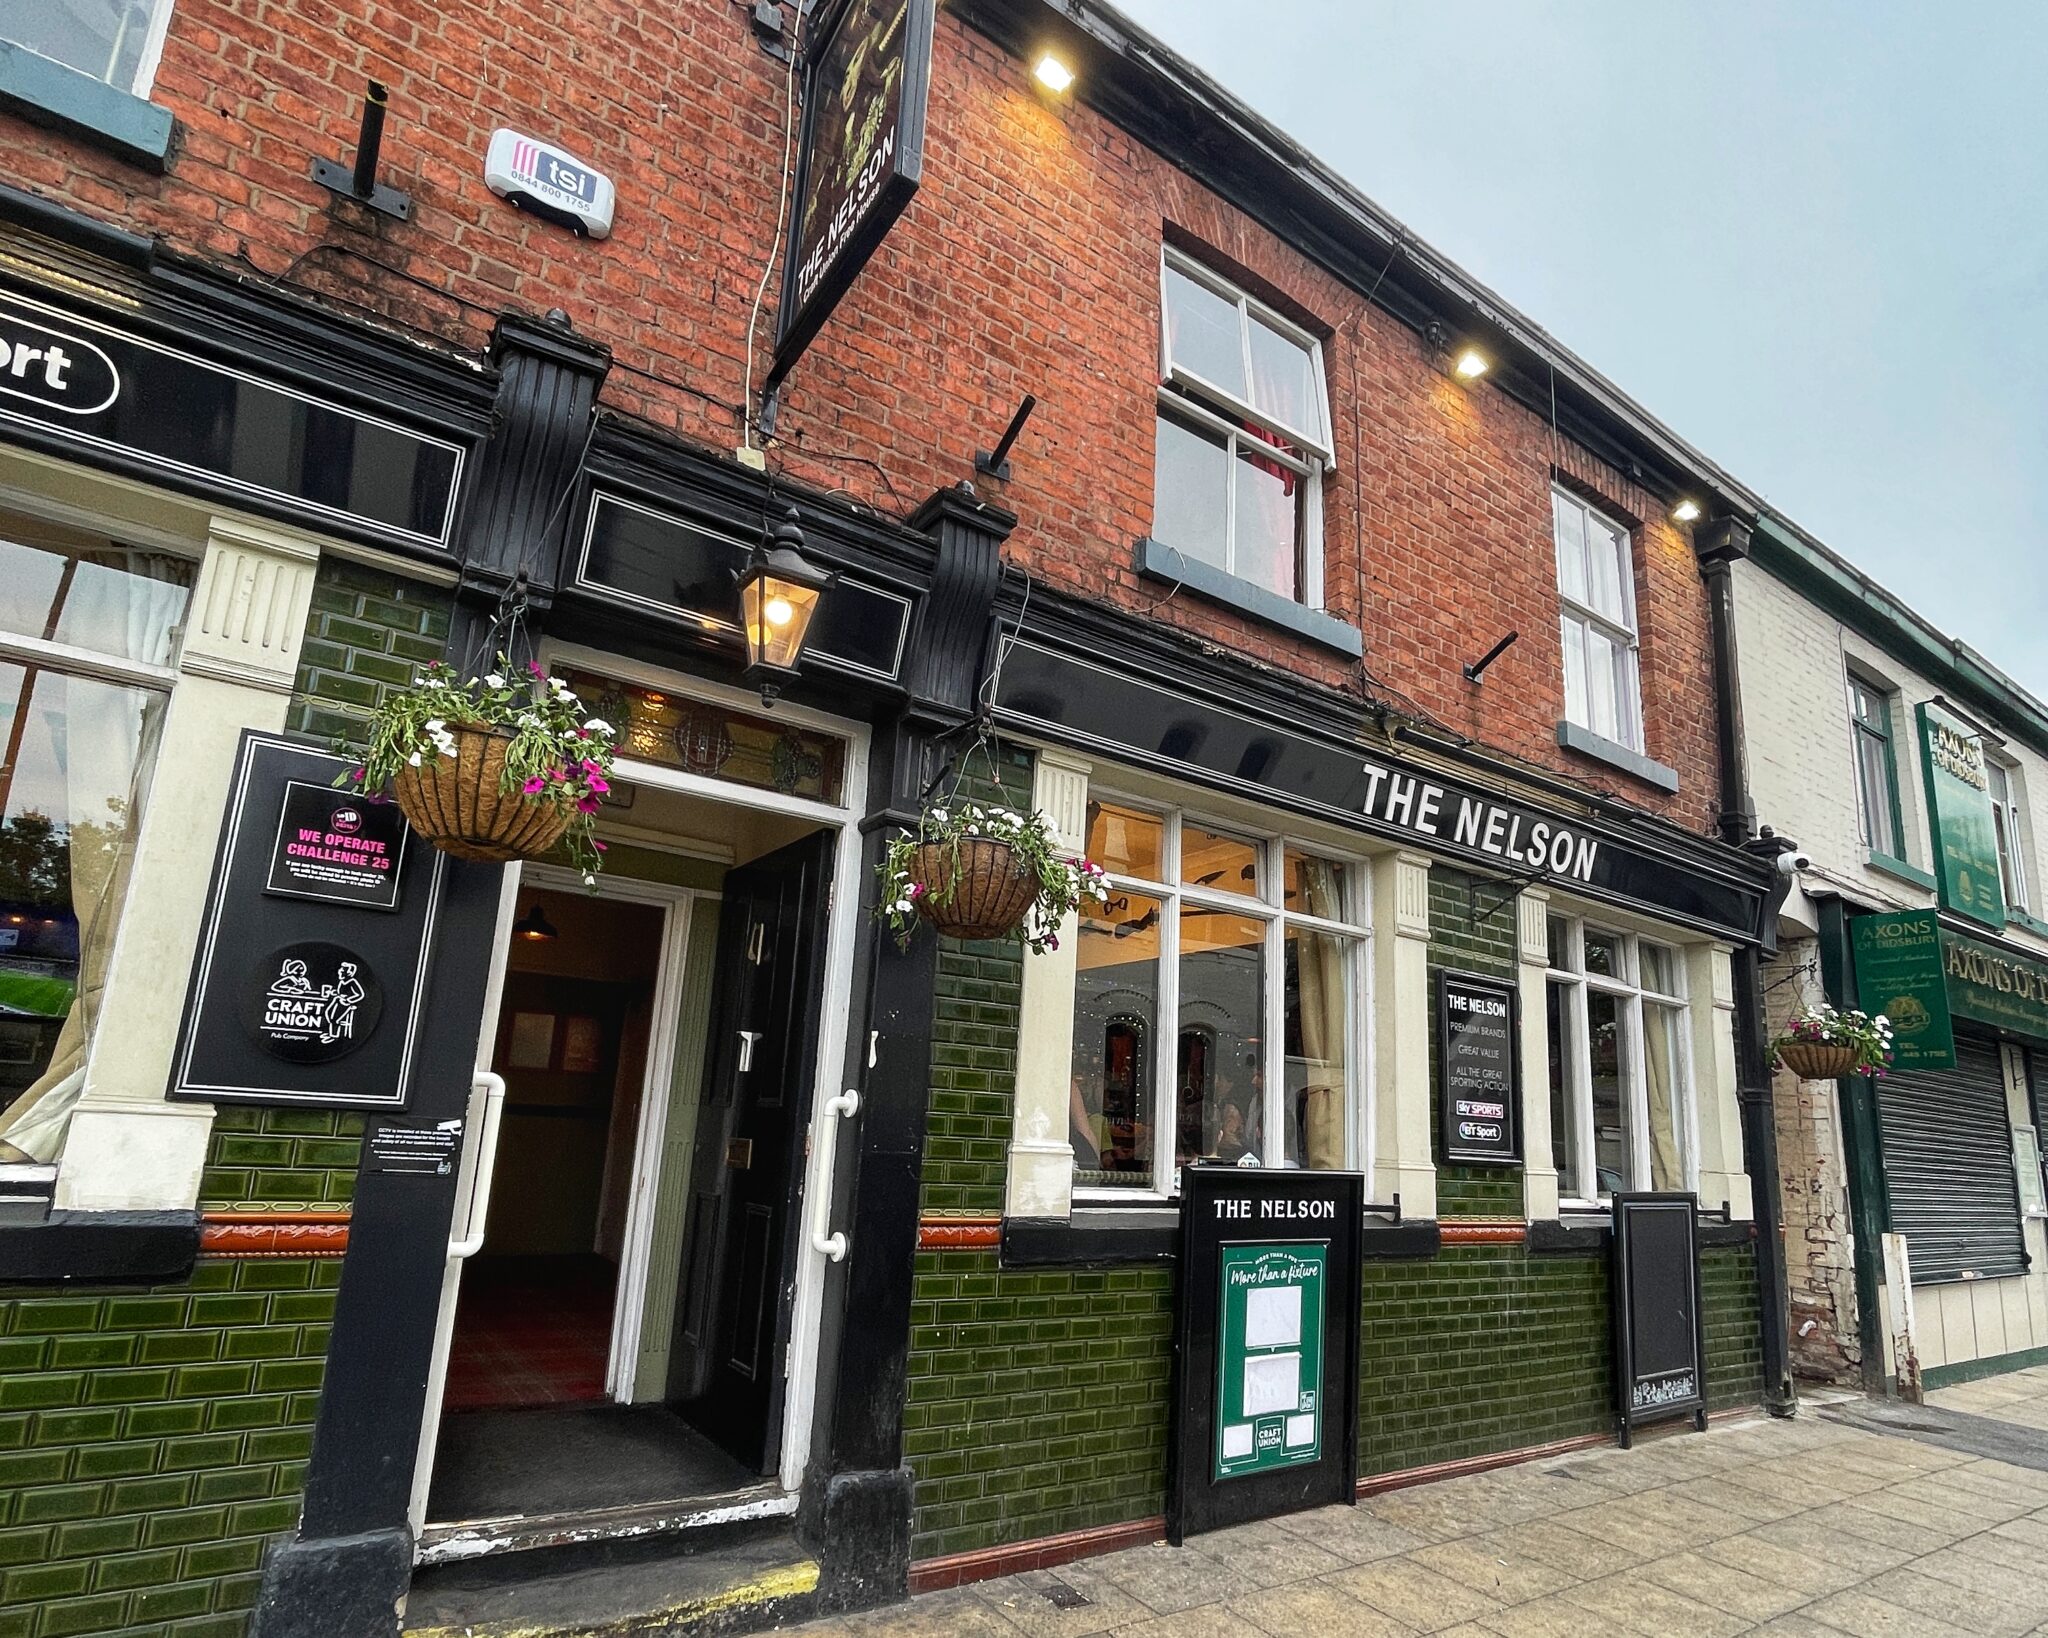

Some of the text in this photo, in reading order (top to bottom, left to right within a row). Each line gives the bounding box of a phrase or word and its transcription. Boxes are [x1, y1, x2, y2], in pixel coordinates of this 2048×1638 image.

[549, 160, 586, 197] tsi
[511, 170, 591, 212] 0844 800 1755
[798, 126, 894, 295] THE NELSON
[839, 220, 855, 249] Free
[856, 182, 881, 224] House
[1363, 763, 1597, 882] THE NELSON
[299, 828, 386, 854] WE OPERATE
[287, 843, 390, 870] CHALLENGE 25
[1861, 920, 1931, 940] AXONS
[1876, 935, 1936, 949] DIDSBURY
[1947, 941, 2012, 993] AXONS
[2013, 964, 2035, 1001] OF
[267, 998, 324, 1015] CRAFT
[1447, 994, 1506, 1018] THE NELSON
[264, 1011, 322, 1028] UNION
[282, 1033, 309, 1042] Company
[1450, 1021, 1506, 1039] PREMIUM BRANDS
[1458, 1044, 1500, 1060] GREAT VALUE
[1456, 1066, 1503, 1080] ALL THE GREAT
[1450, 1076, 1509, 1092] SPORTING ACTION
[1458, 1102, 1501, 1116] sky SPORTS
[1464, 1125, 1497, 1139] BT Sport
[1213, 1199, 1335, 1219] THE NELSON
[1230, 1262, 1318, 1286] More than a fixture
[1258, 1427, 1282, 1439] CRAFT
[1258, 1436, 1282, 1448] UNION
